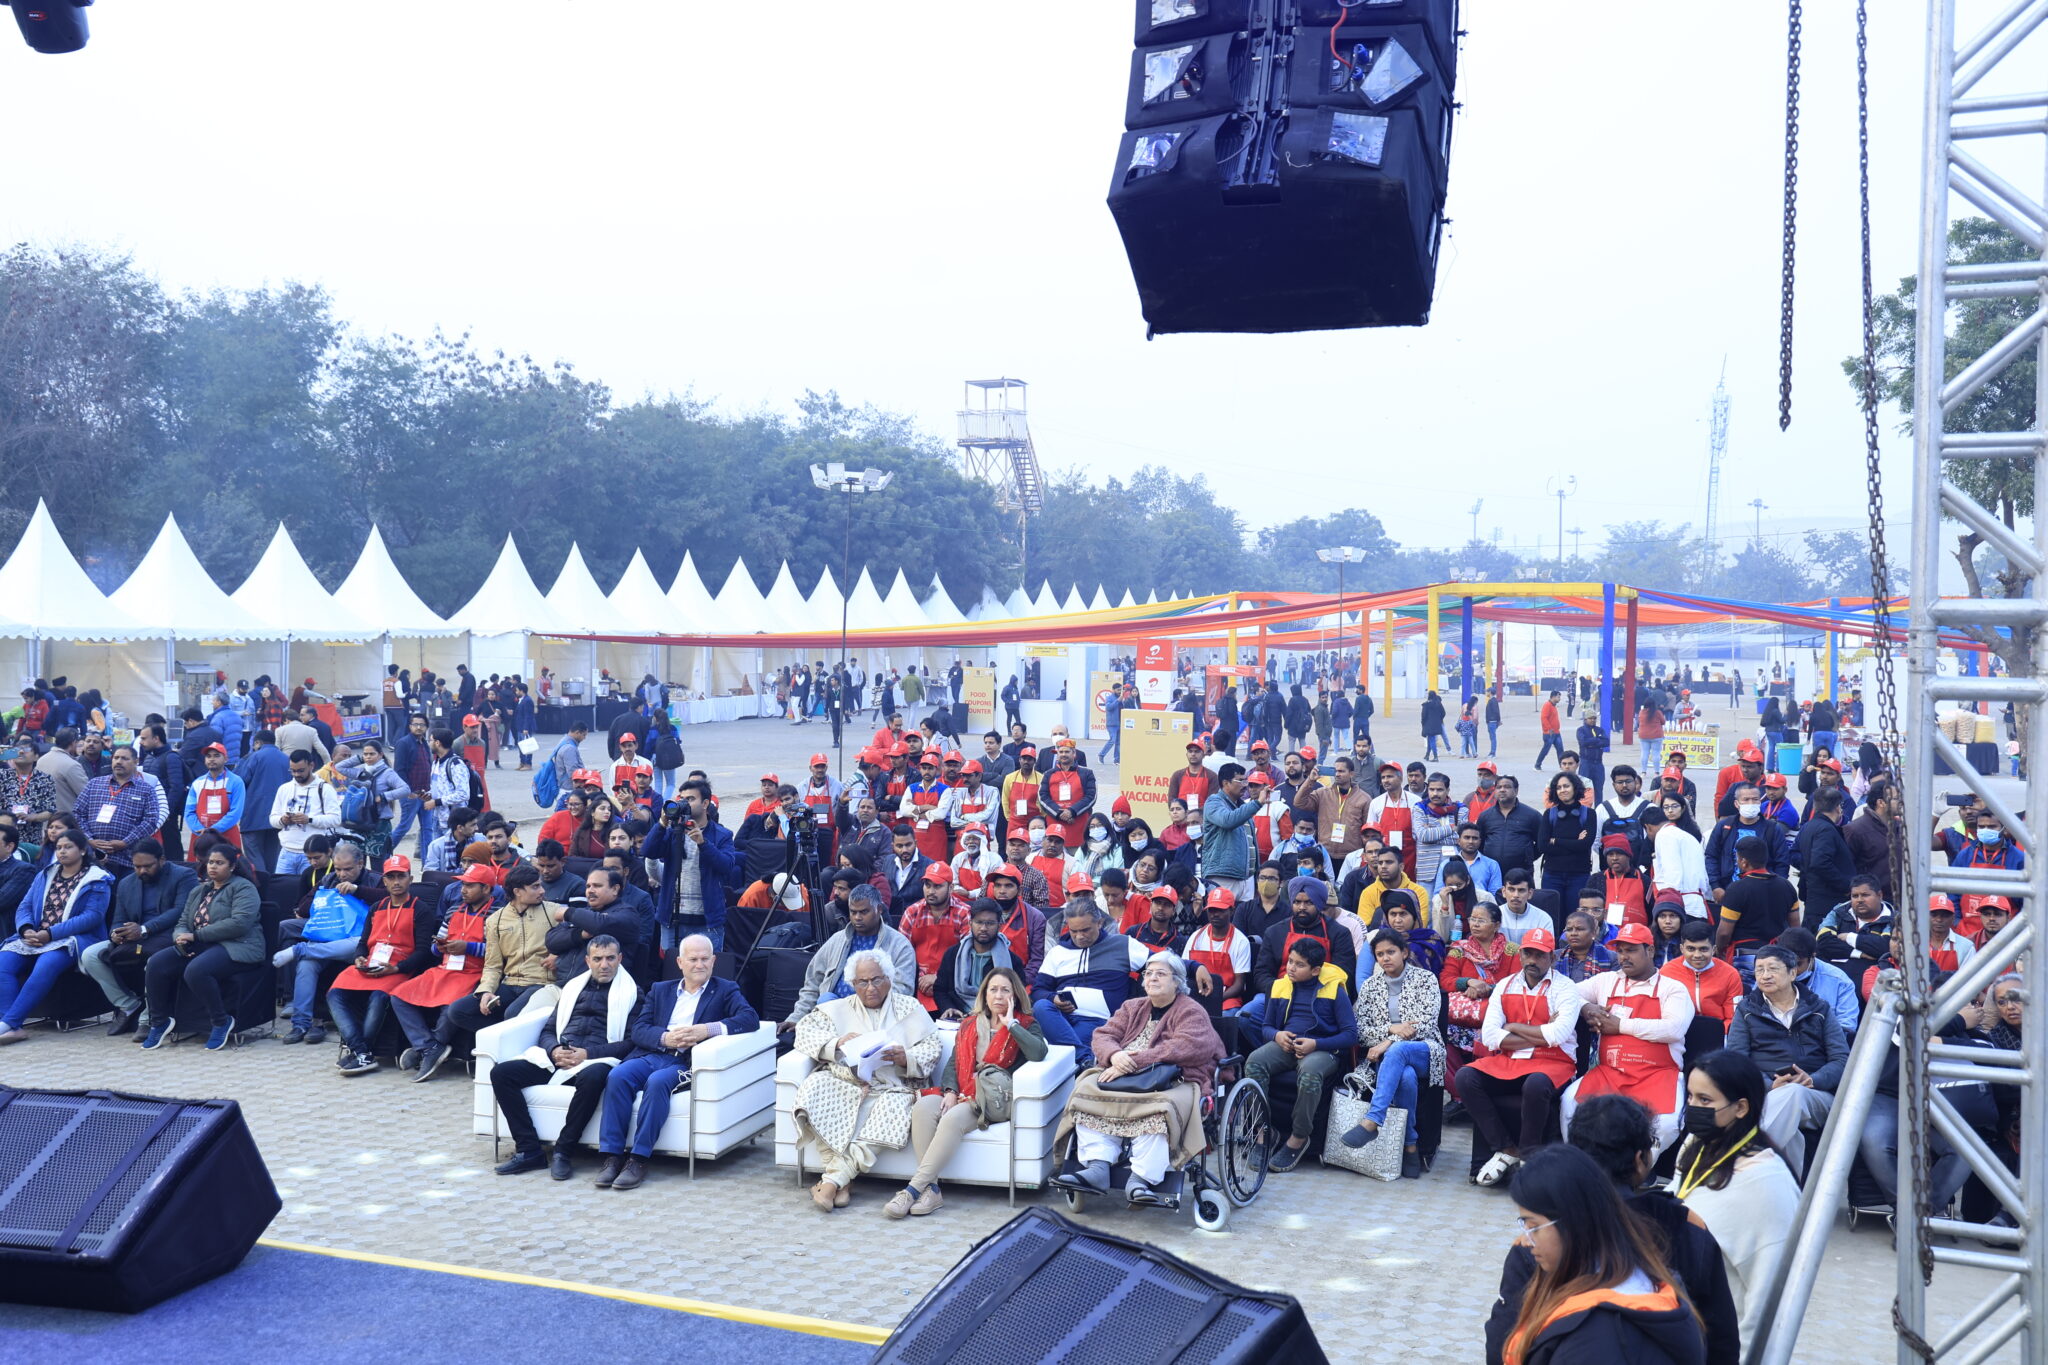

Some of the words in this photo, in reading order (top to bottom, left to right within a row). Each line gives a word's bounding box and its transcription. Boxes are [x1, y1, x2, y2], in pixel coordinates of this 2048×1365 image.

[1668, 741, 1689, 753] जोर
[1691, 745, 1714, 753] गरम
[1134, 775, 1152, 786] WE
[1154, 777, 1170, 787] AR
[1121, 791, 1169, 803] VACCINA
